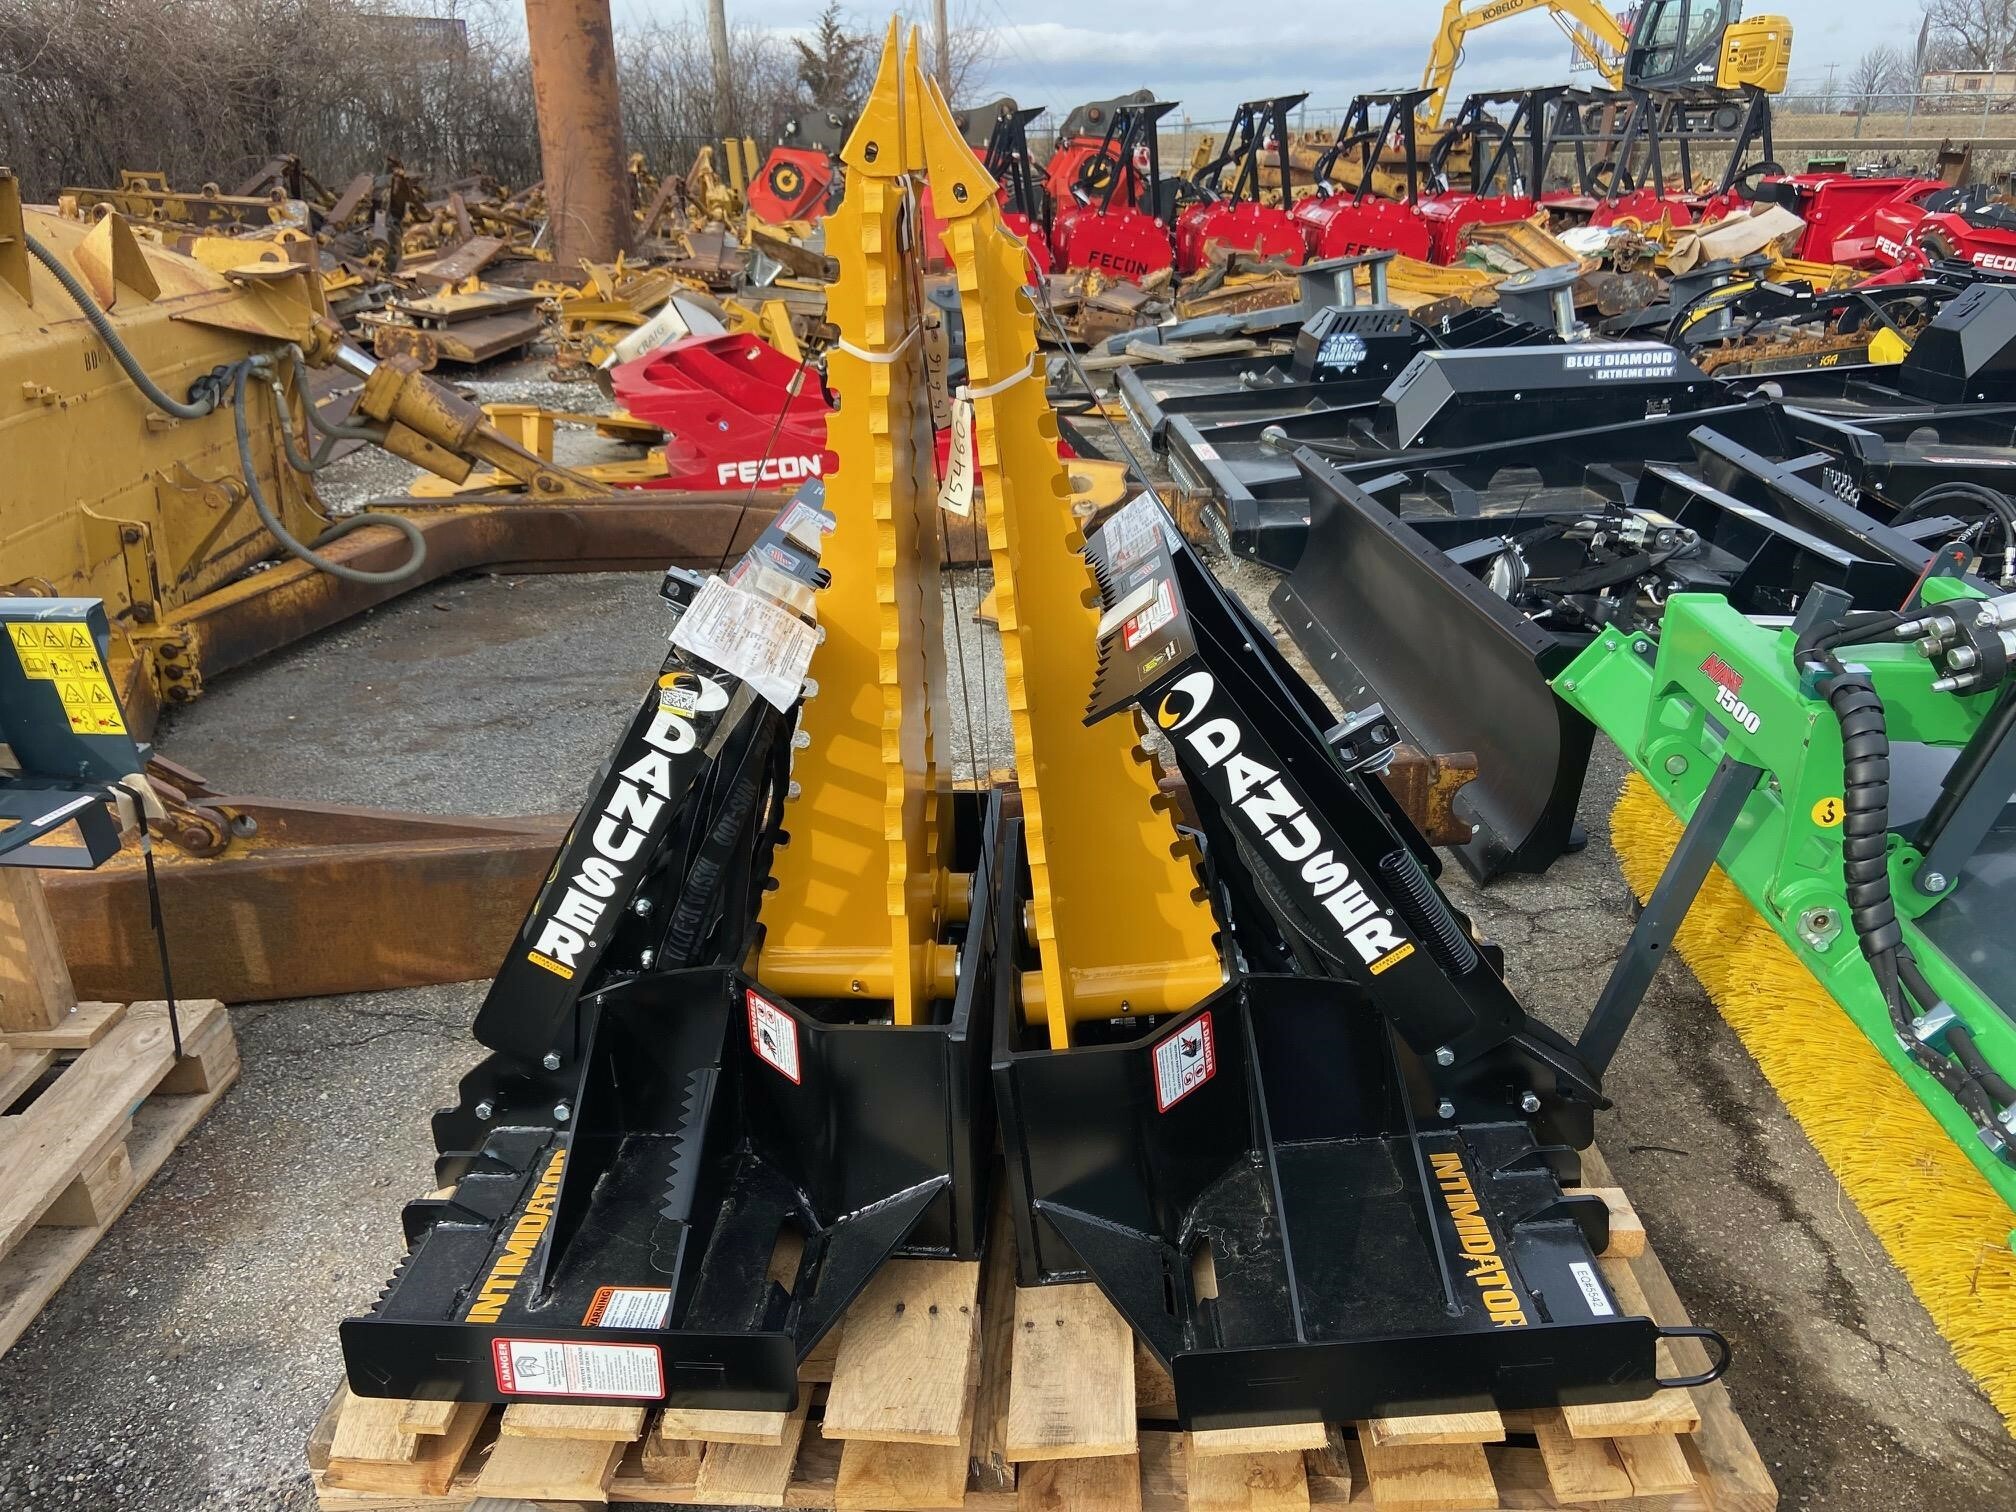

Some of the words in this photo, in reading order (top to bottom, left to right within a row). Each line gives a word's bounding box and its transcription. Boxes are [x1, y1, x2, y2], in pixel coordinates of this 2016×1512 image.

[1482, 0, 1524, 21] KOBELCO
[1089, 251, 1149, 275] FECON
[1973, 251, 2016, 271] FECO
[636, 324, 665, 355] CRAIG
[1330, 343, 1355, 352] BLUE
[1317, 350, 1367, 362] DIAMOND
[1566, 355, 1601, 368] BLUE
[1604, 352, 1672, 366] DIAMOND
[1597, 369, 1643, 379] EXTREME
[1645, 367, 1673, 377] DUTY
[717, 454, 822, 486] FECON
[945, 421, 966, 506] 15460
[1714, 685, 1761, 734] 1500
[750, 998, 758, 1039] DANGER
[1203, 1028, 1213, 1073] DANGER
[1577, 1270, 1603, 1308] EQ#5542
[498, 1343, 511, 1381] DANGER
